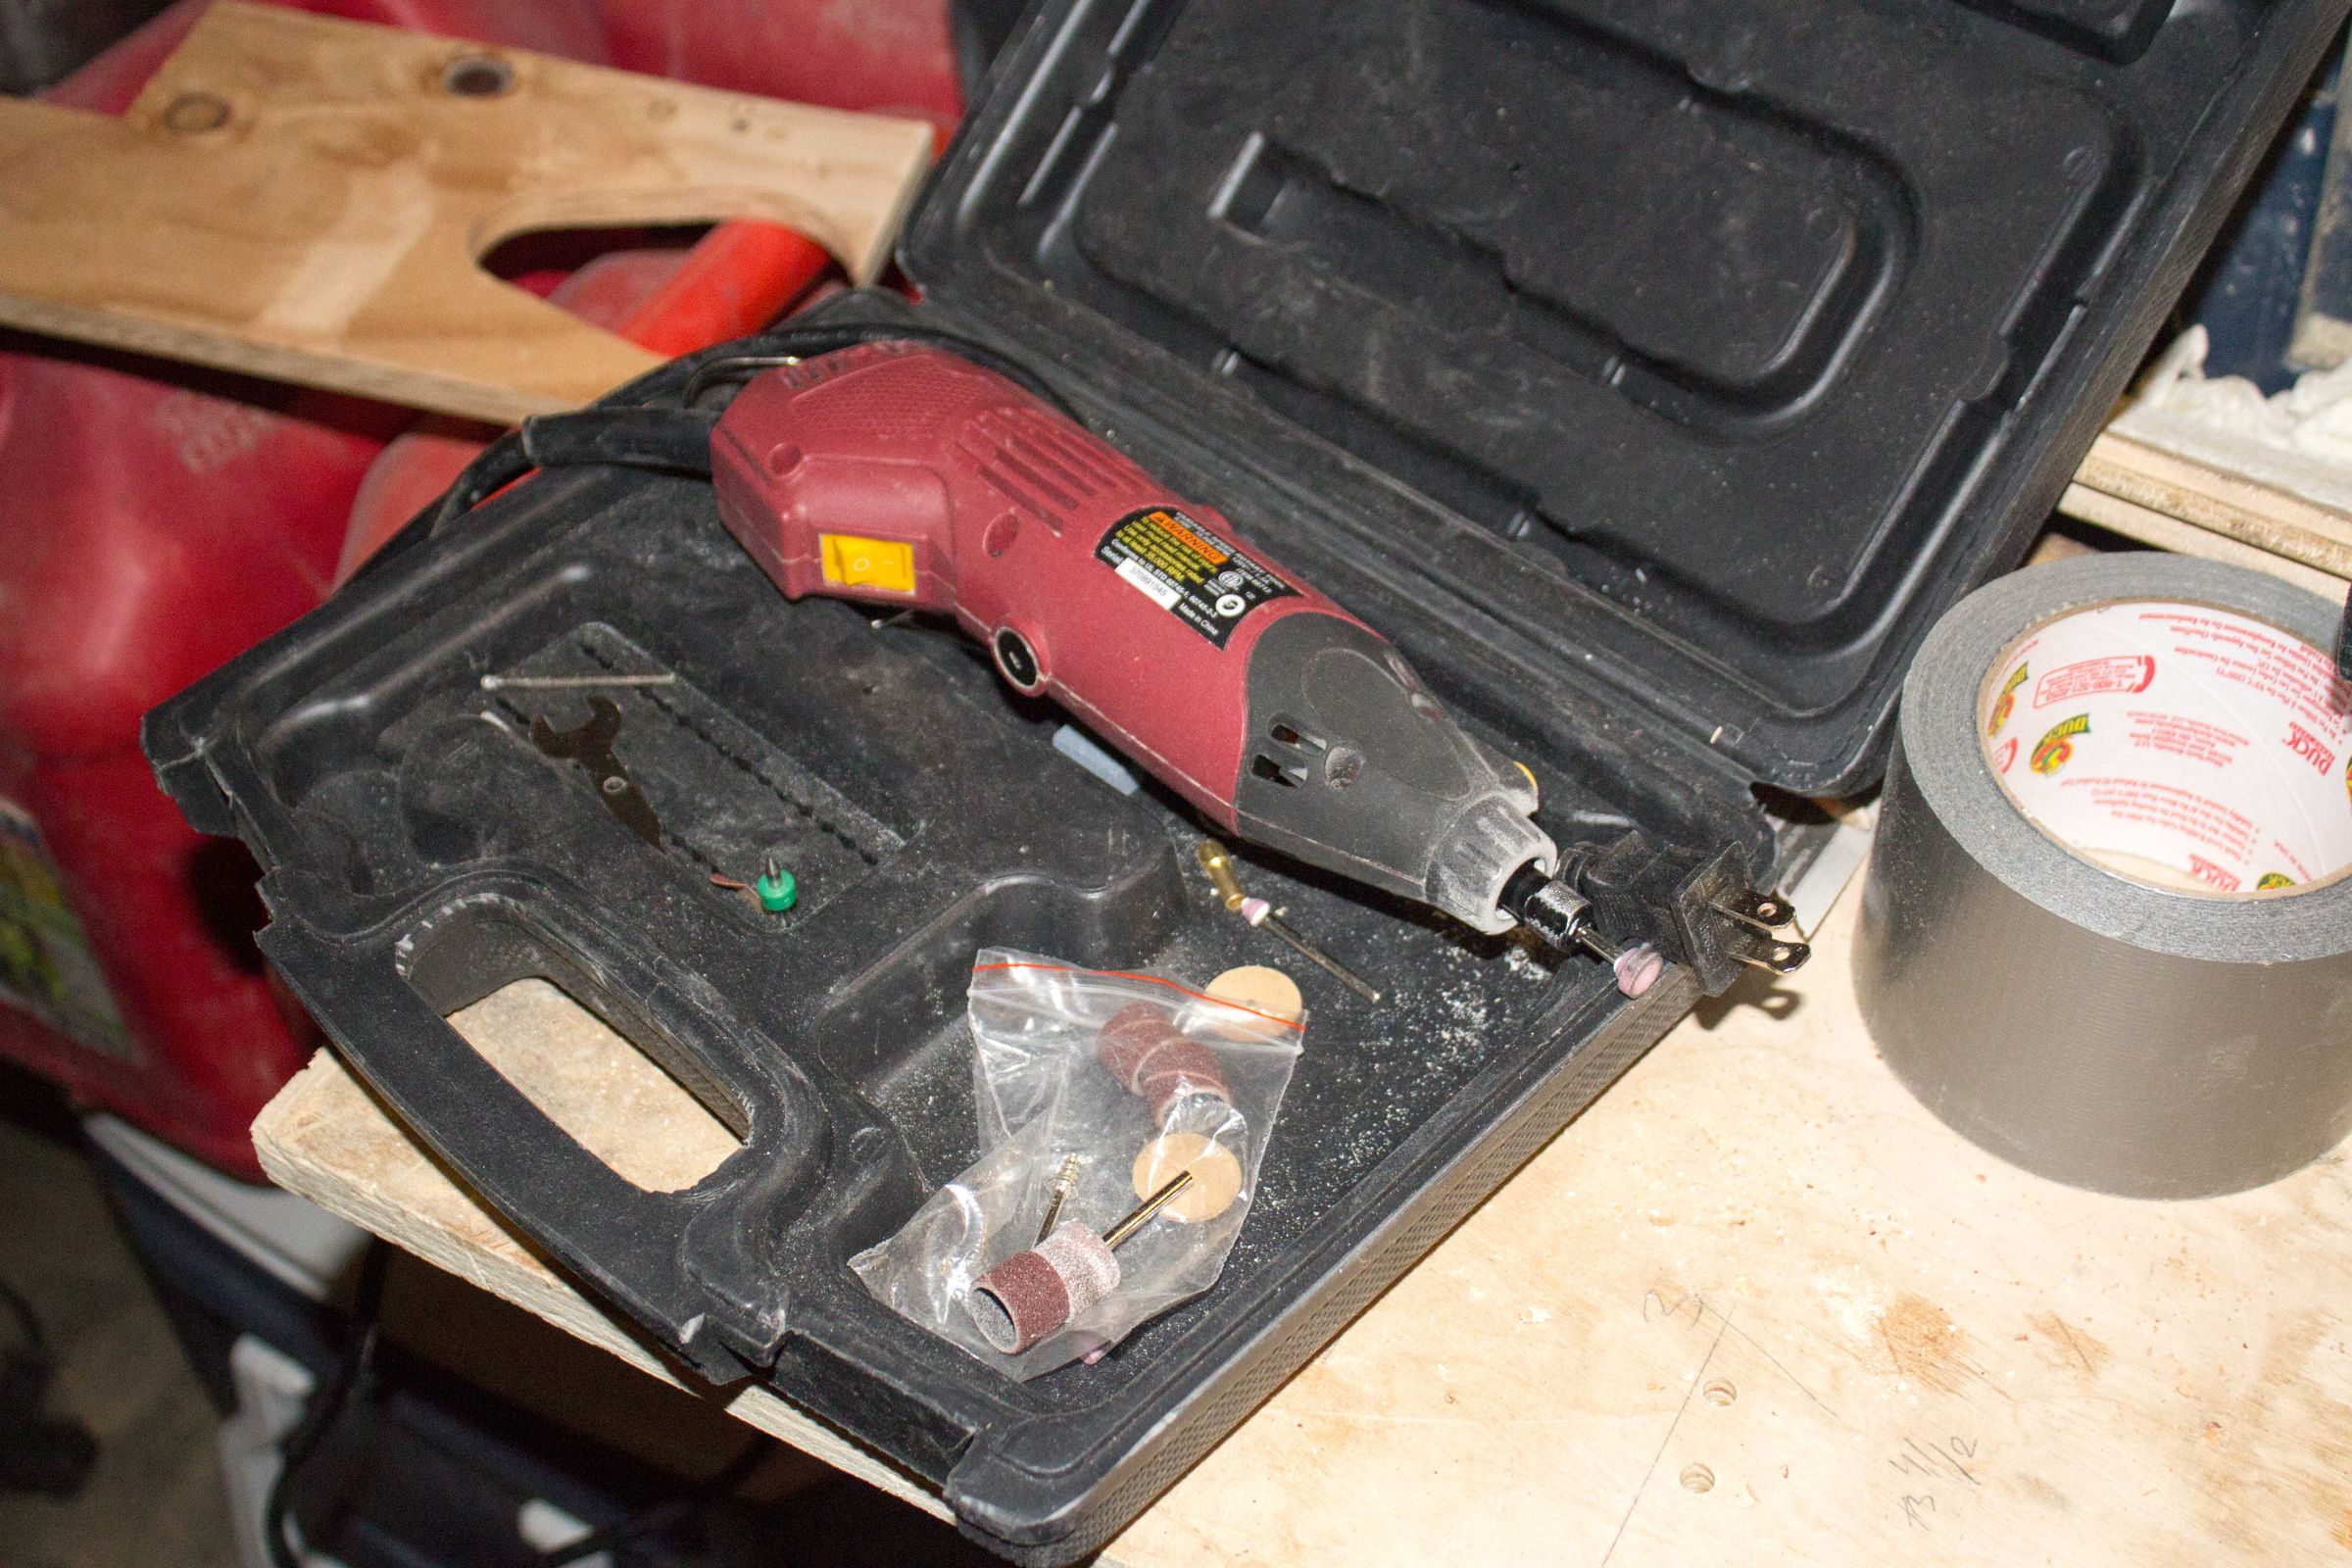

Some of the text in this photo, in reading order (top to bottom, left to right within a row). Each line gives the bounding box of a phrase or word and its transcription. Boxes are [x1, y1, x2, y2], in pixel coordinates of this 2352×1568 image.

[1110, 538, 1140, 561] Conforms
[1152, 568, 1168, 580] STD
[1164, 520, 1220, 559] WARNING
[1178, 603, 1197, 617] Made
[1200, 619, 1220, 634] China
[2287, 735, 2331, 777] DUCK
